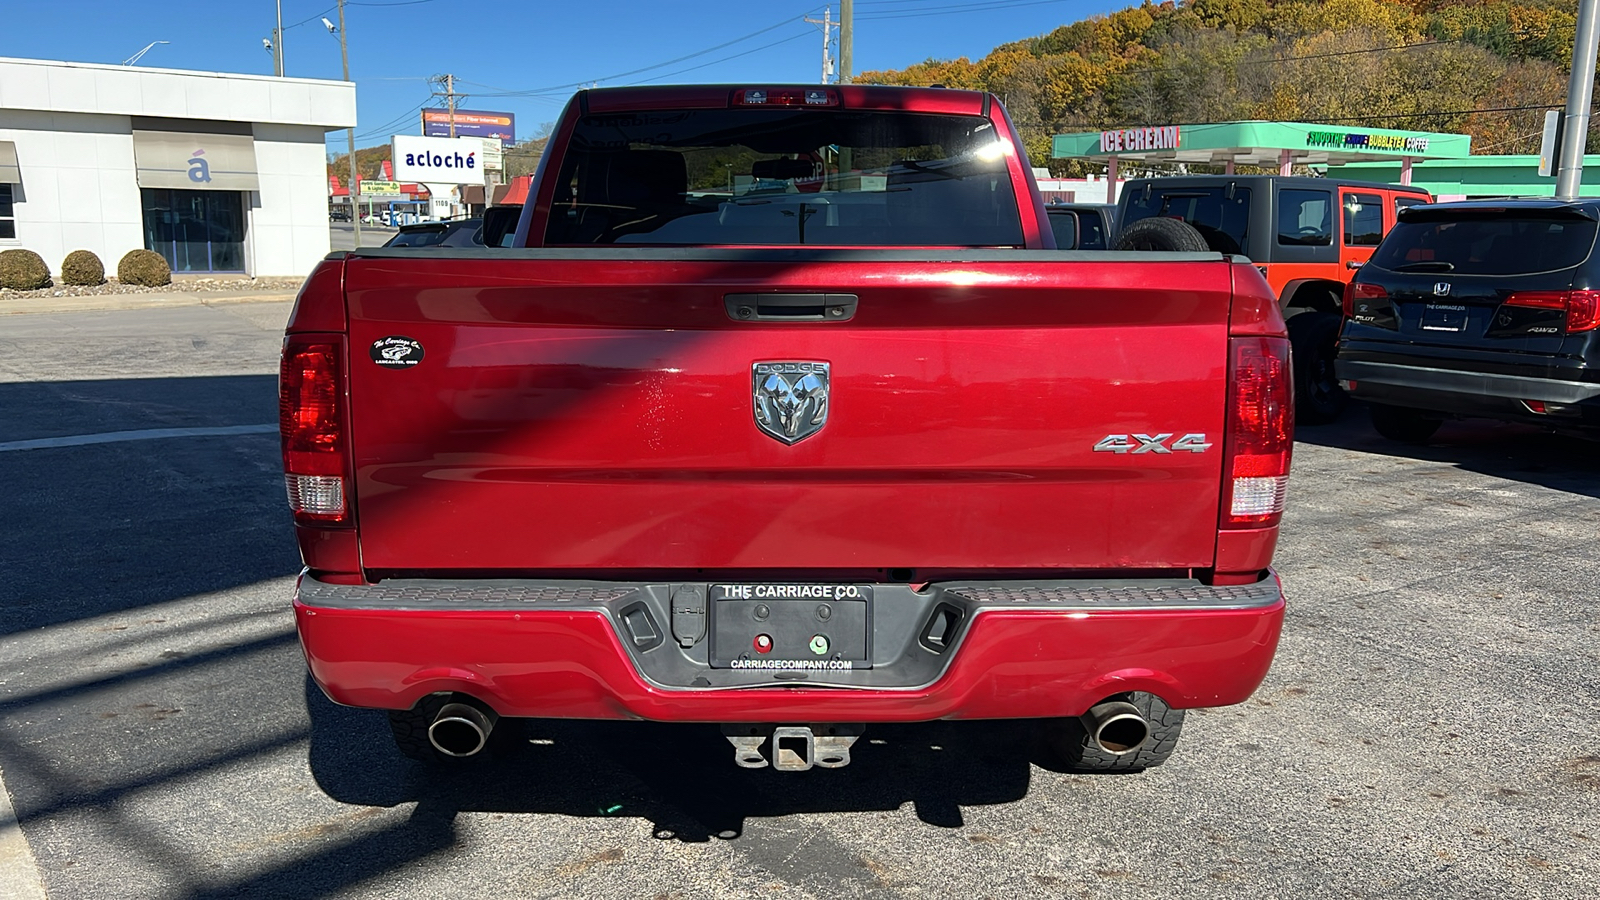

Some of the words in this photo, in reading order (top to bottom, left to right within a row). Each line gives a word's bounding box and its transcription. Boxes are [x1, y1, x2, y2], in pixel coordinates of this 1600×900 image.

[1100, 130, 1124, 152] ICE
[1125, 126, 1180, 151] CREAM
[1406, 137, 1430, 150] COFFEE
[187, 149, 212, 183] á
[406, 150, 475, 169] acloché
[374, 340, 384, 348] The
[758, 364, 824, 374] DODGE
[722, 585, 752, 597] THE
[756, 585, 832, 598] CARRIAGE
[834, 585, 860, 598] CO.
[730, 660, 852, 669] CARRIAGECOMPANY.COM
